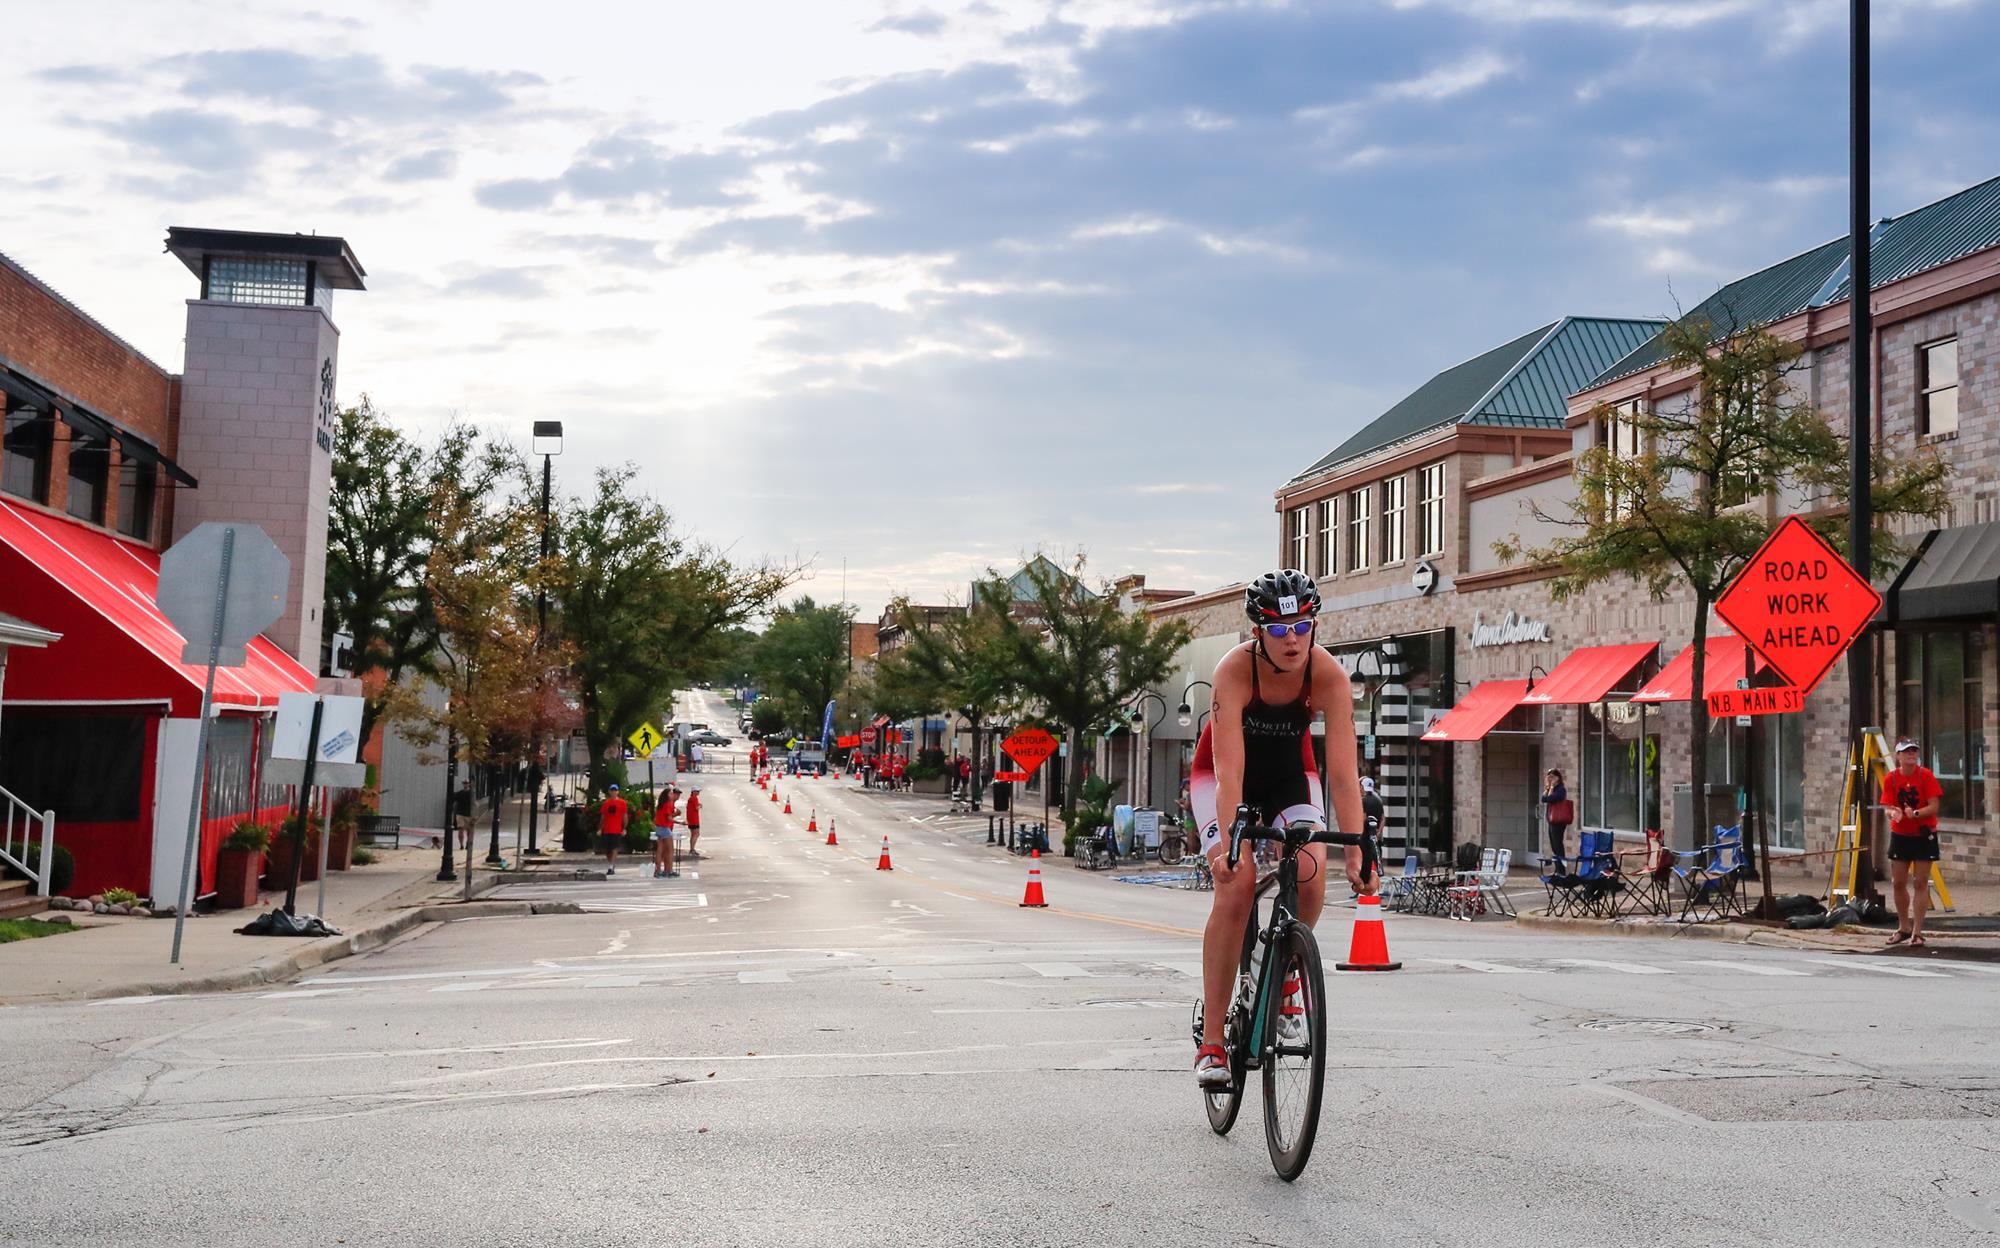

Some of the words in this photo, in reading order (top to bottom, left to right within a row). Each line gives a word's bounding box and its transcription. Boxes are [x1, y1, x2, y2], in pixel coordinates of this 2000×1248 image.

[1765, 560, 1828, 582] ROAD
[1281, 601, 1295, 610] 101
[1767, 593, 1830, 615] WORK
[1762, 625, 1841, 649] AHEAD
[1711, 694, 1735, 713] N.B.
[1743, 691, 1777, 712] MAIN
[1783, 690, 1799, 709] ST
[1248, 716, 1292, 730] NORTH
[862, 731, 876, 739] STOP
[1013, 736, 1048, 745] DETOUR
[1013, 747, 1047, 757] AHEAD
